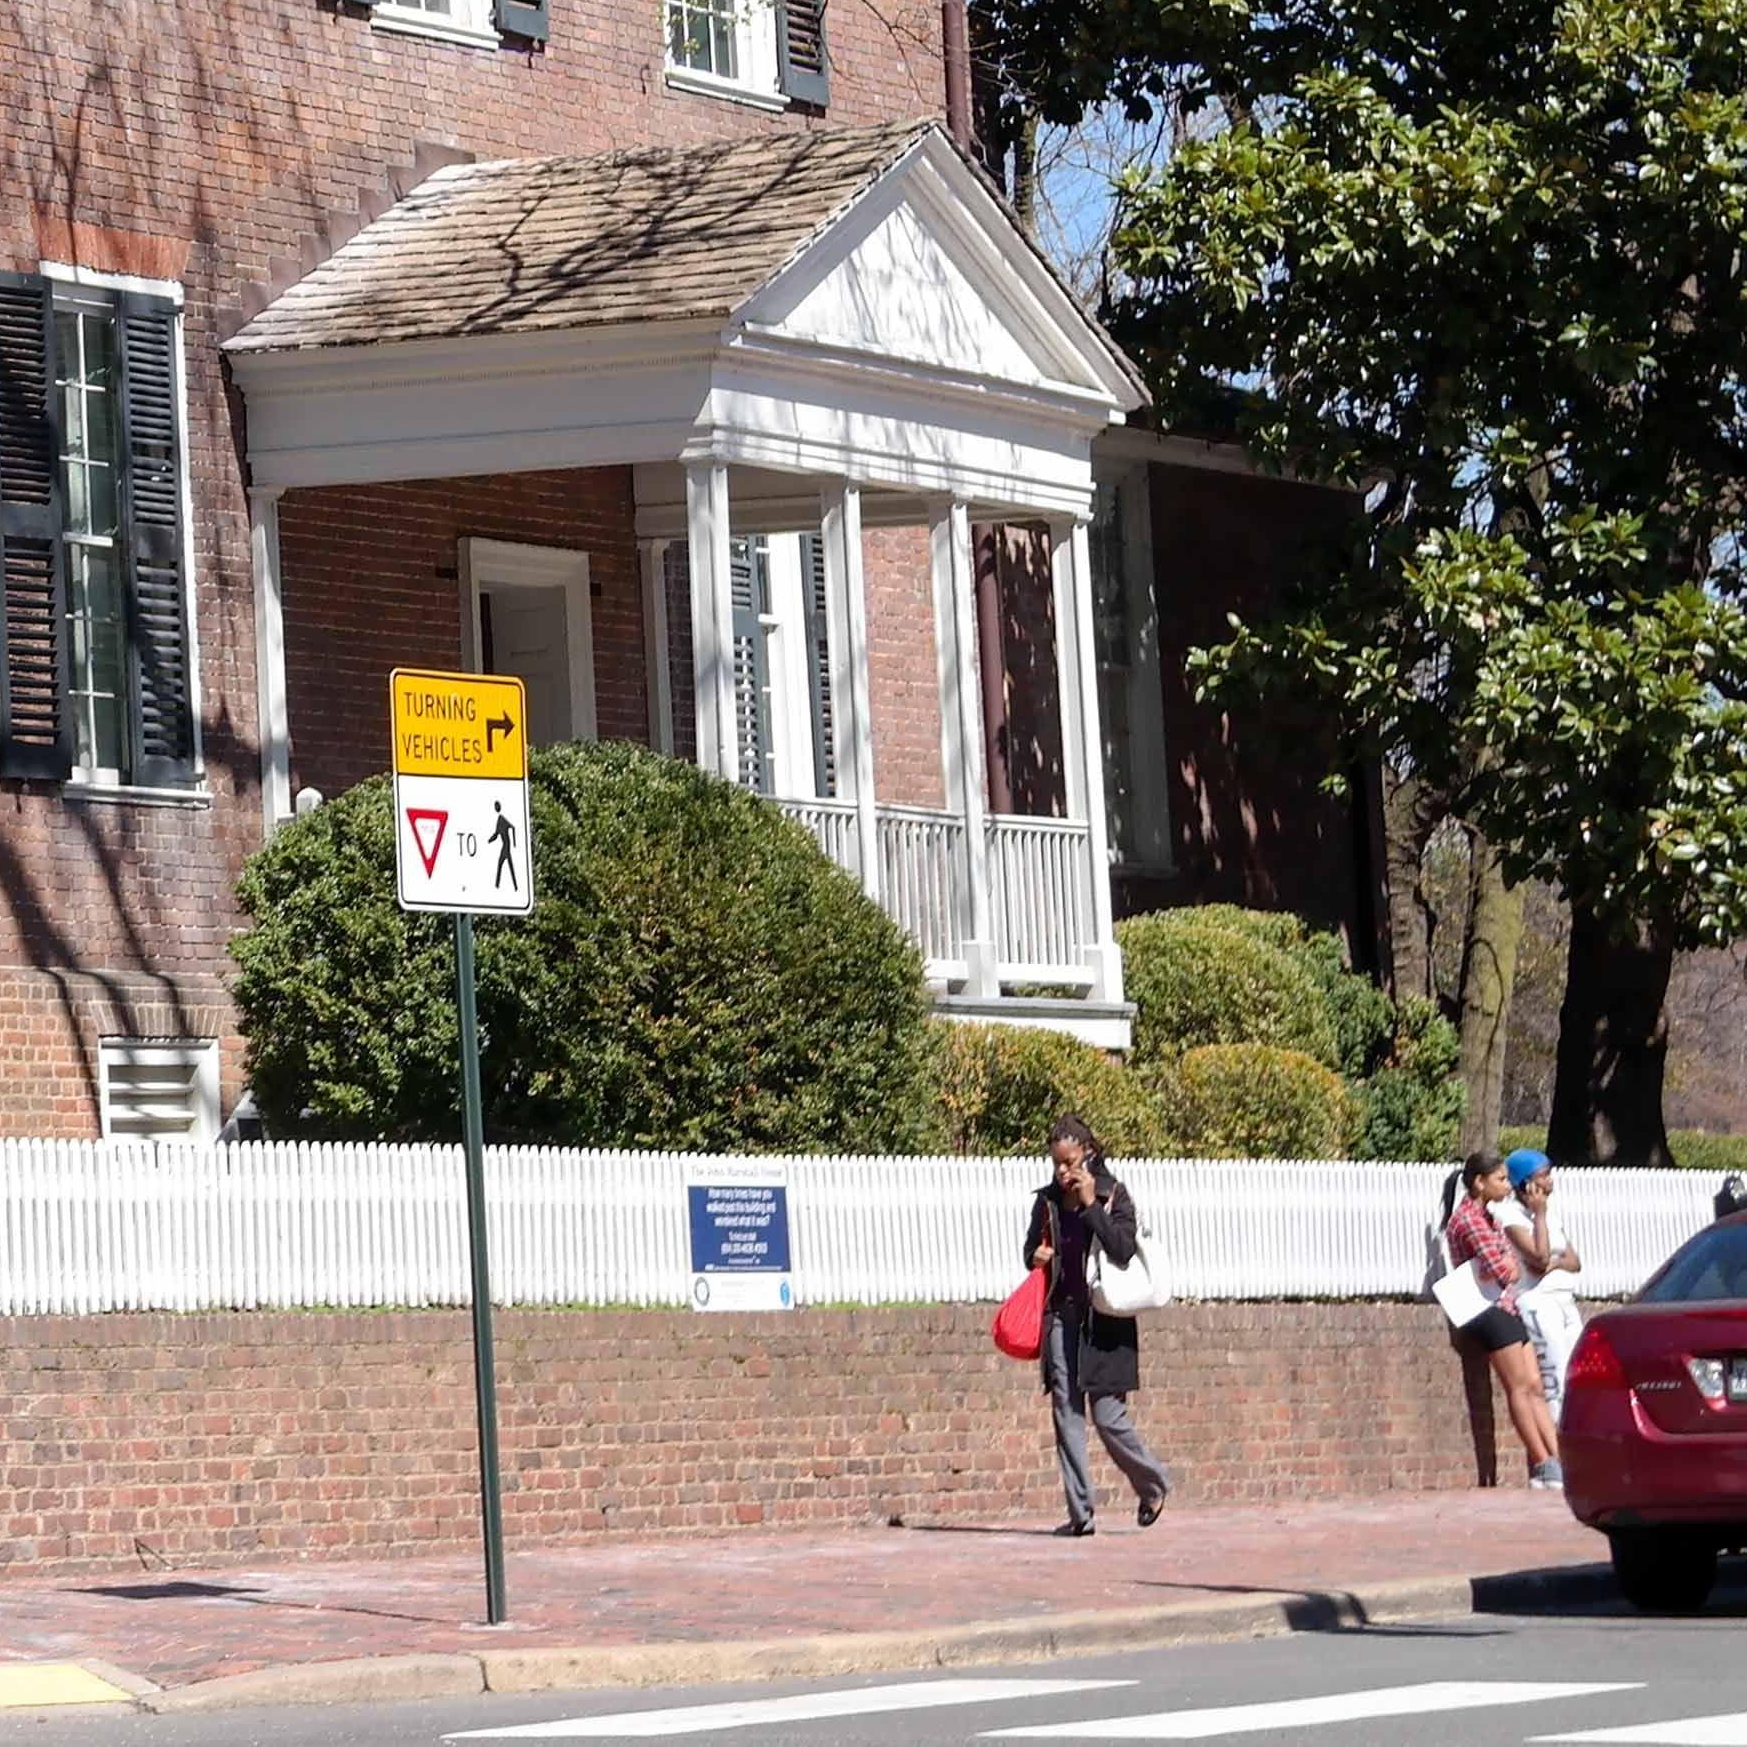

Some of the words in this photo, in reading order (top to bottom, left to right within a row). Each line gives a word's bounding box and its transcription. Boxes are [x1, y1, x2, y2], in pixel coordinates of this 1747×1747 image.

[403, 691, 477, 722] TURNING
[402, 732, 483, 764] VEHICLES
[455, 832, 478, 858] TO
